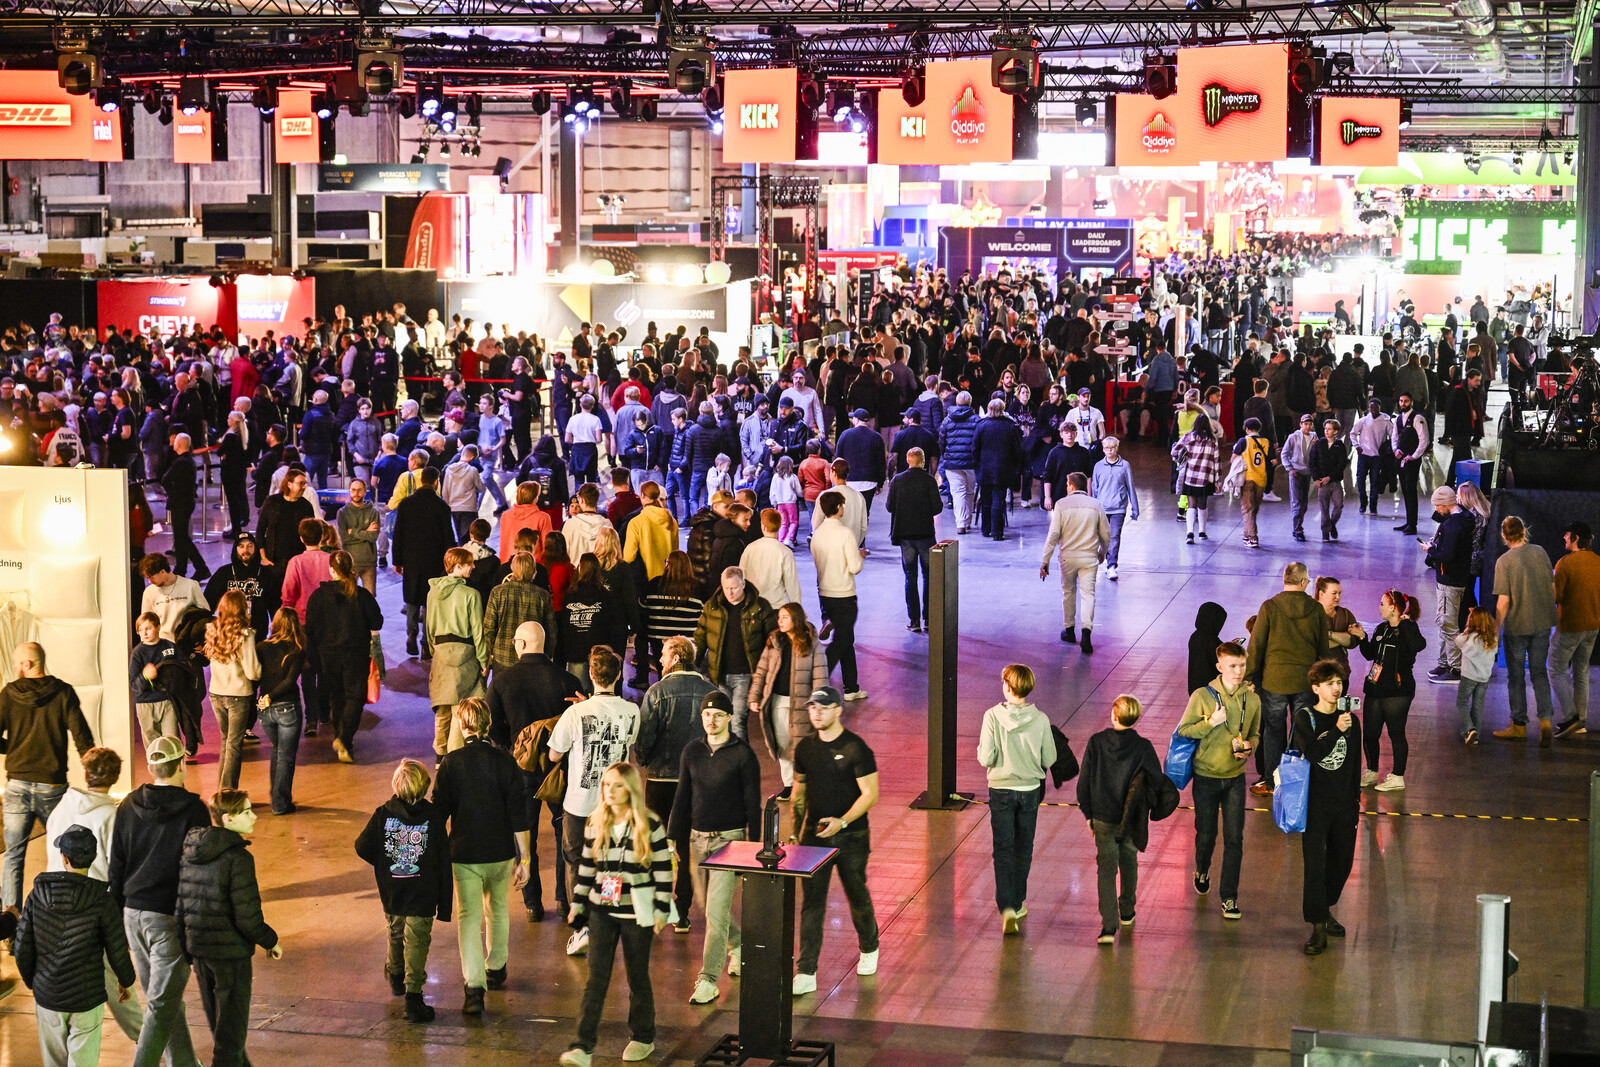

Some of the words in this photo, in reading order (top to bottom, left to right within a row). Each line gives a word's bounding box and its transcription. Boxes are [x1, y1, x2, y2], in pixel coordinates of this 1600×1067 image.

[1221, 93, 1259, 105] MONSTER
[0, 108, 59, 121] DHL
[740, 103, 778, 129] KICK
[93, 119, 112, 140] intel
[286, 121, 307, 132] DHL
[900, 116, 925, 138] KI
[951, 119, 985, 134] Qiddiya
[1354, 125, 1381, 135] MONSTER
[1142, 135, 1175, 148] Qiddiya
[988, 242, 1052, 252] WELCOME!
[138, 314, 196, 335] CHEW
[1253, 451, 1263, 467] 6
[54, 495, 72, 504] Ljus
